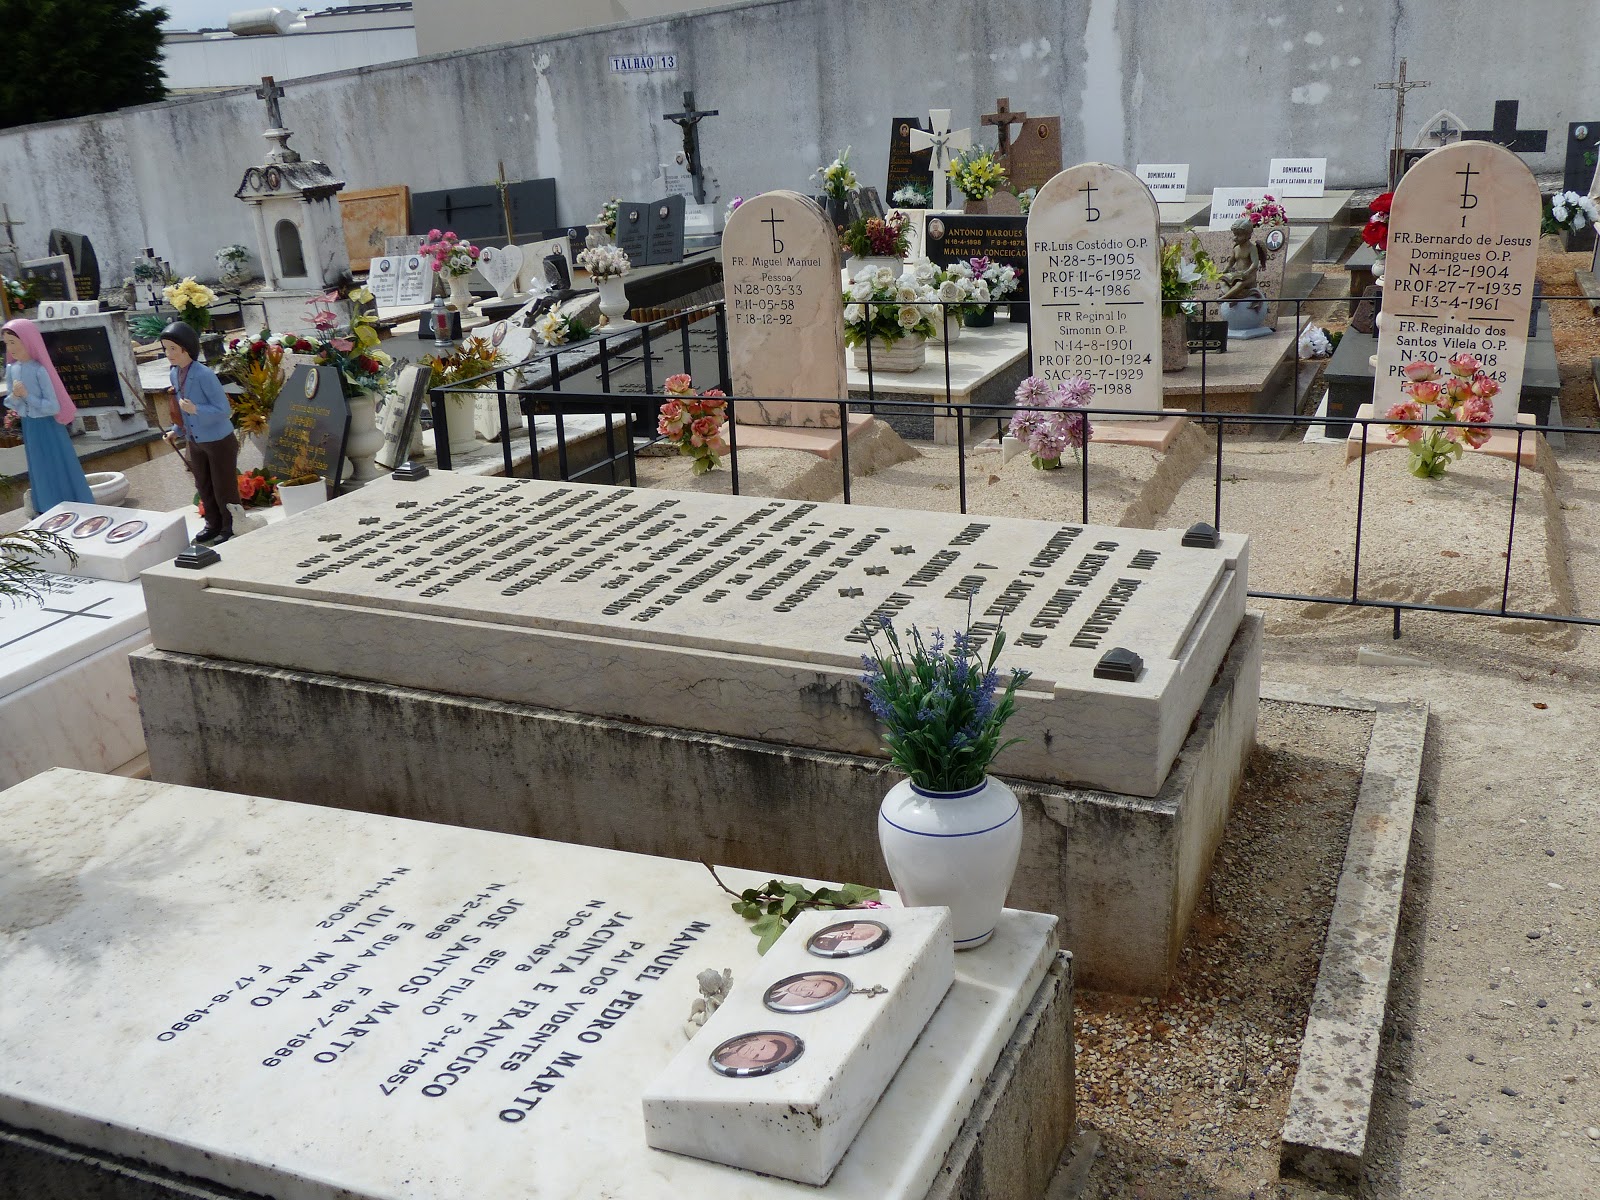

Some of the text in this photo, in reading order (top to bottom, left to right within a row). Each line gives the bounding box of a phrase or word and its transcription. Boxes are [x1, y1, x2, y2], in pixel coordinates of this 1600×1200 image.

[661, 56, 674, 68] 13
[944, 248, 969, 256] MARIA
[971, 248, 982, 256] DA
[986, 229, 1023, 238] MARQUES
[1076, 239, 1123, 250] Costódio
[1126, 238, 1148, 249] O.P.
[1476, 234, 1492, 246] de
[1496, 235, 1532, 247] Jesus
[752, 257, 783, 269] Miguel
[786, 257, 821, 267] Manuel
[1411, 248, 1512, 262] Domingues O.P.
[762, 273, 792, 282] Pessoa
[1059, 325, 1101, 336] Simonin
[1396, 336, 1437, 347] Santos
[1443, 338, 1477, 350] Vilela
[1485, 325, 1506, 336] dos
[947, 522, 991, 546] NOSSA
[1028, 526, 1084, 568] FRANCISCO
[901, 549, 961, 588] SENHORA
[943, 575, 988, 601] QUEM
[1018, 569, 1045, 578] E
[982, 579, 1035, 619] JACINTA
[1013, 541, 1120, 649] OS RESTOS MORTAIS DE
[1069, 548, 1161, 650] AQUI DESCANSARAM
[156, 867, 411, 1042] N 11-11-1902 F 17-6-1990
[250, 904, 395, 1007] JULIA MARTO
[302, 922, 416, 1000] E SUA NORA
[261, 883, 506, 1068] N 1-2-1899 F 19-7-1989
[313, 898, 525, 1064] JOSE SANTOS MARTO
[421, 949, 507, 1016] SEU FILHO
[378, 899, 607, 1097] N 30-6-1878 F 3-11-1957
[421, 911, 633, 1098] JACINTA E FRANCISCO
[500, 940, 646, 1072] PAI DOS VIDENTES
[498, 920, 712, 1124] MANUEL PEDRO MARTO
